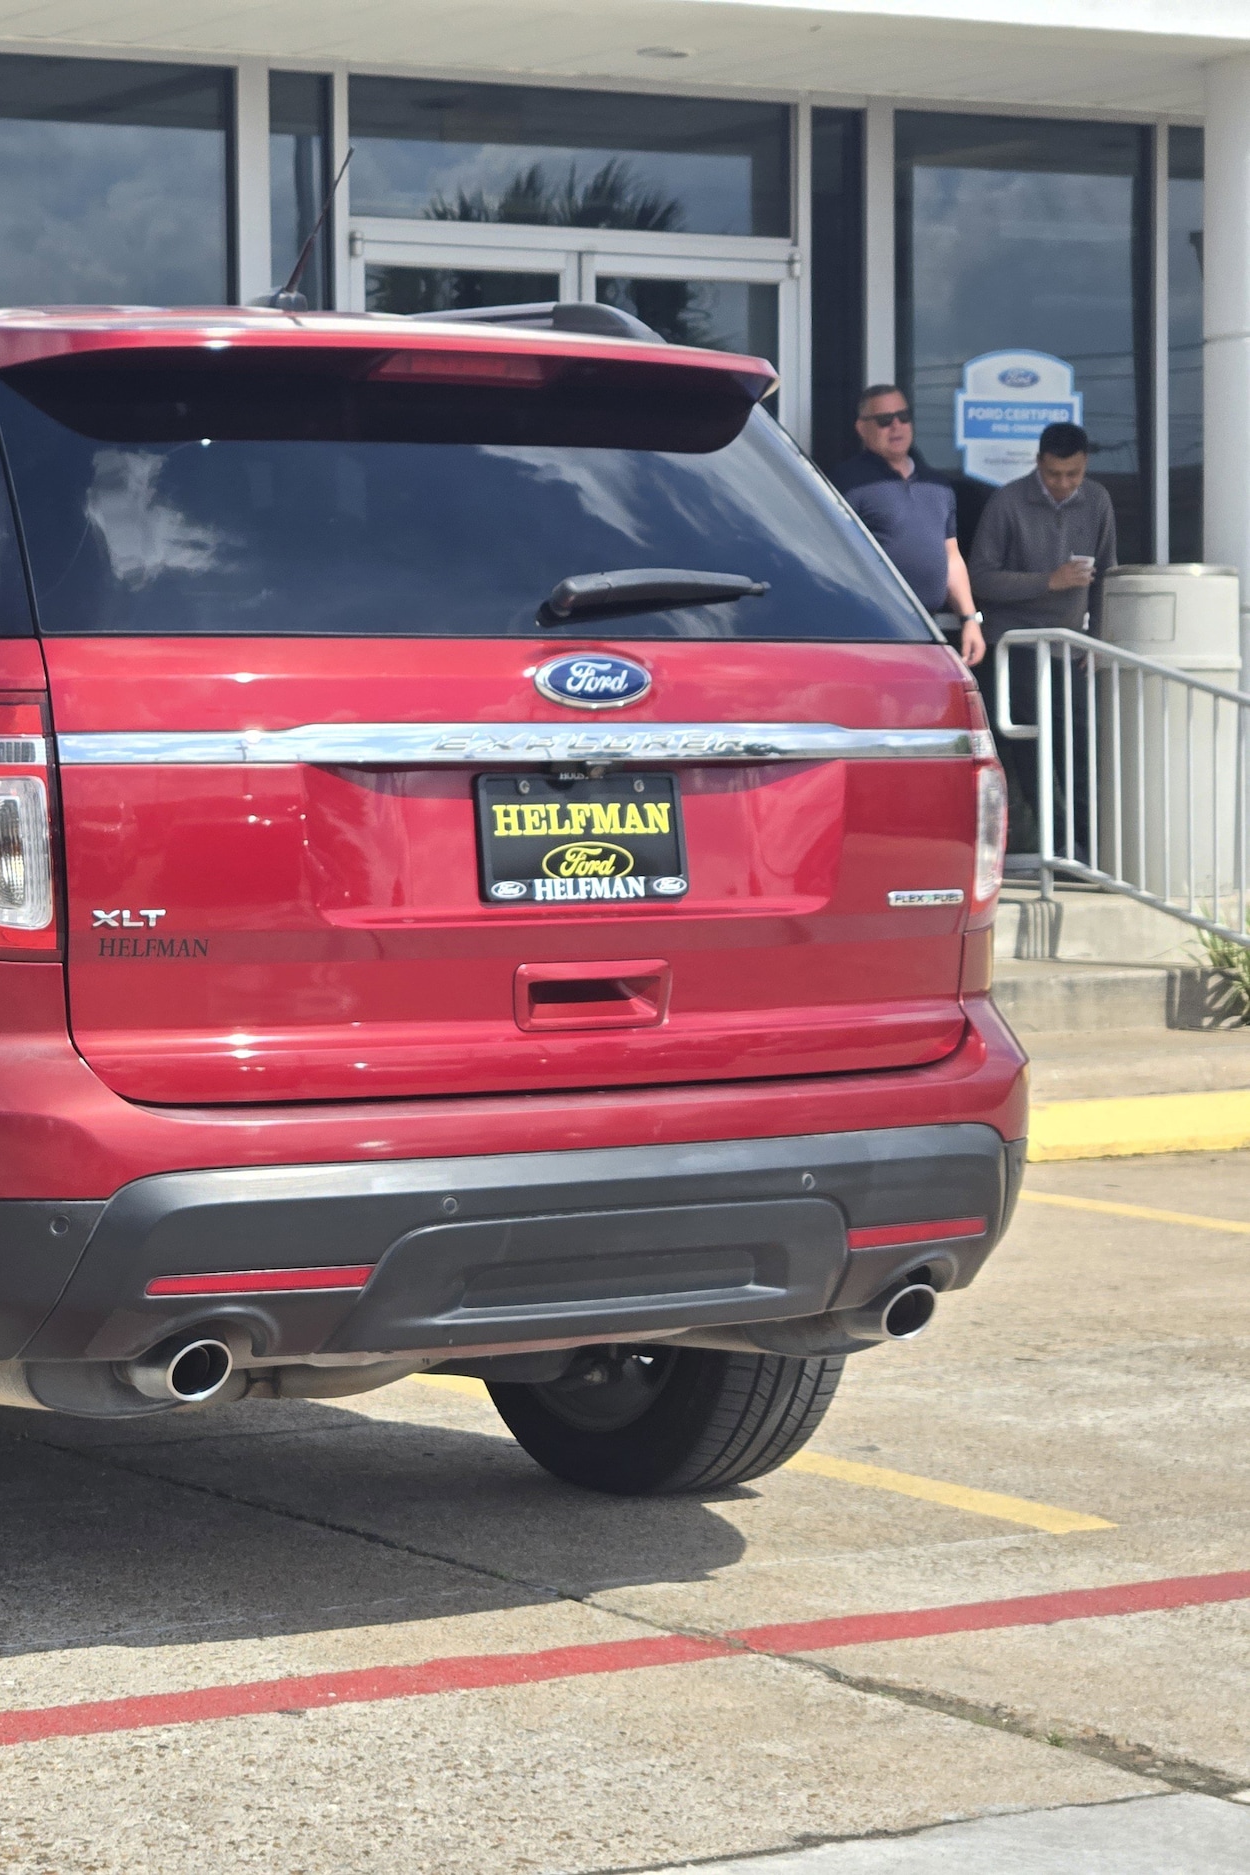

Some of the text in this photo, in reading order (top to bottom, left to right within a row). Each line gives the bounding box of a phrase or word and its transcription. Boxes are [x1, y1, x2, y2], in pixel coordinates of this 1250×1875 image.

[967, 407, 1070, 422] FORD CERTIFIED
[565, 661, 629, 693] Ford
[434, 731, 746, 752] EXPLORER
[492, 803, 671, 836] HELFMAN
[559, 846, 616, 877] Ford
[534, 876, 646, 900] HELFMAN
[894, 893, 960, 903] FLEX FUEL
[92, 909, 167, 928] XLT
[98, 938, 209, 957] HELFMAN
